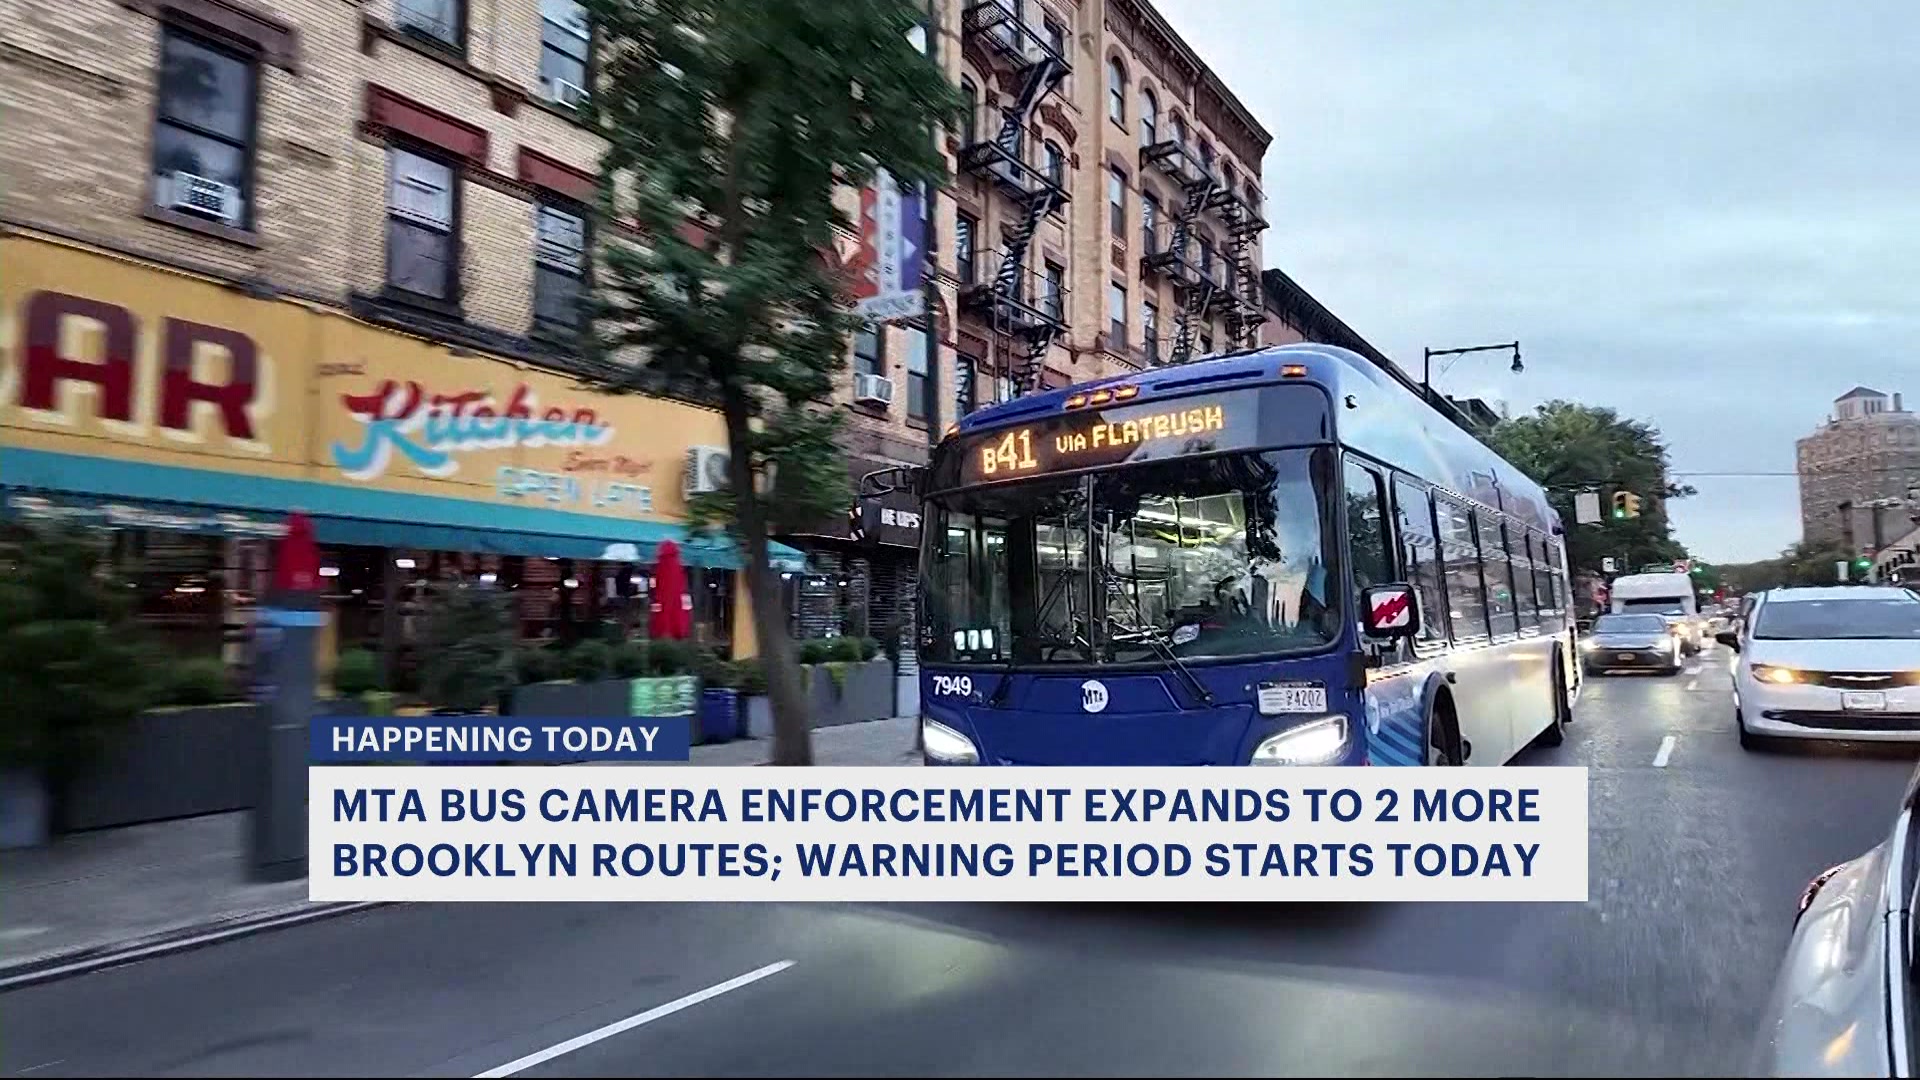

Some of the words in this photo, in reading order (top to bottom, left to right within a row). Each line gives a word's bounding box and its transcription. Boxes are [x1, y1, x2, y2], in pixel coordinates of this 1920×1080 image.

[0, 289, 272, 452] AR
[331, 379, 612, 480] Kitchen
[982, 429, 1038, 474] B41
[1056, 433, 1087, 454] VIA
[1092, 405, 1223, 449] FLATBUSH
[933, 676, 972, 696] 7949
